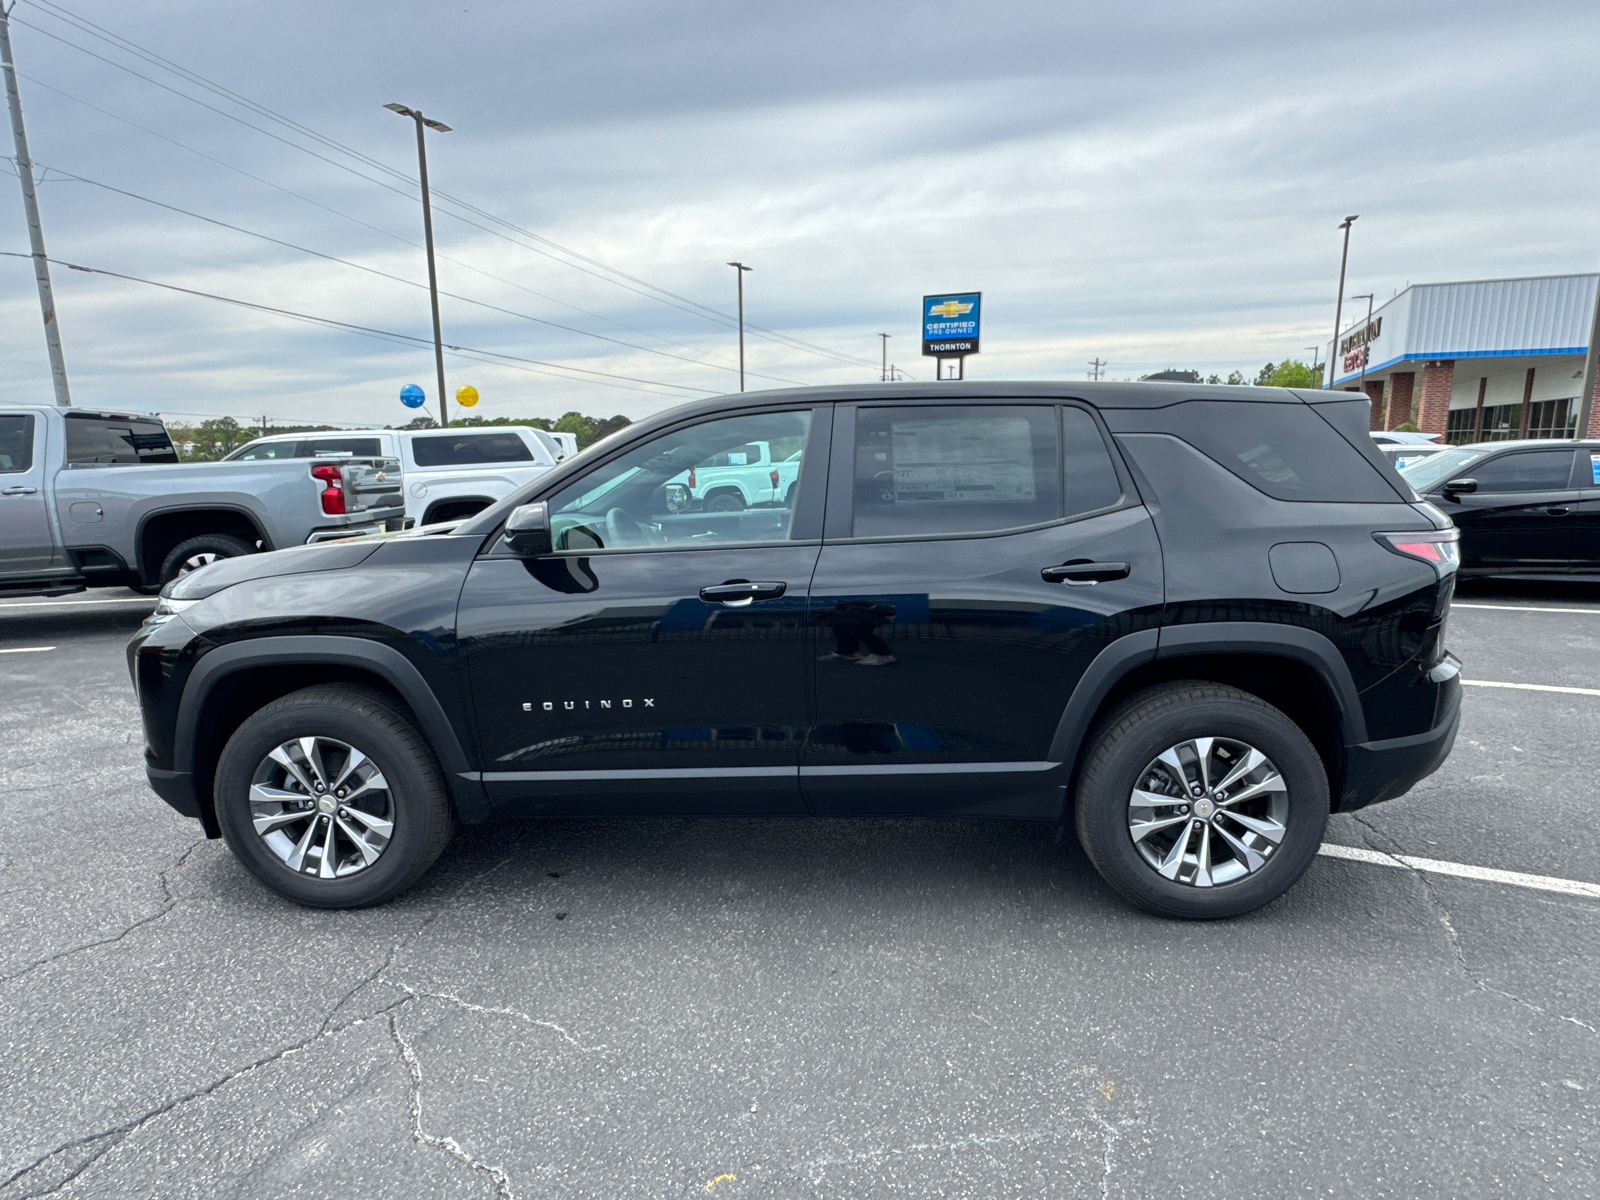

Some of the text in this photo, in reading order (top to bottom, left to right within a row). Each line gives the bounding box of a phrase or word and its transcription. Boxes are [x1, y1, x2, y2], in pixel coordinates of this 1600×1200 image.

[926, 321, 976, 330] CERTIFIED
[930, 342, 971, 351] THORNTON
[522, 698, 655, 711] EQUINOX
